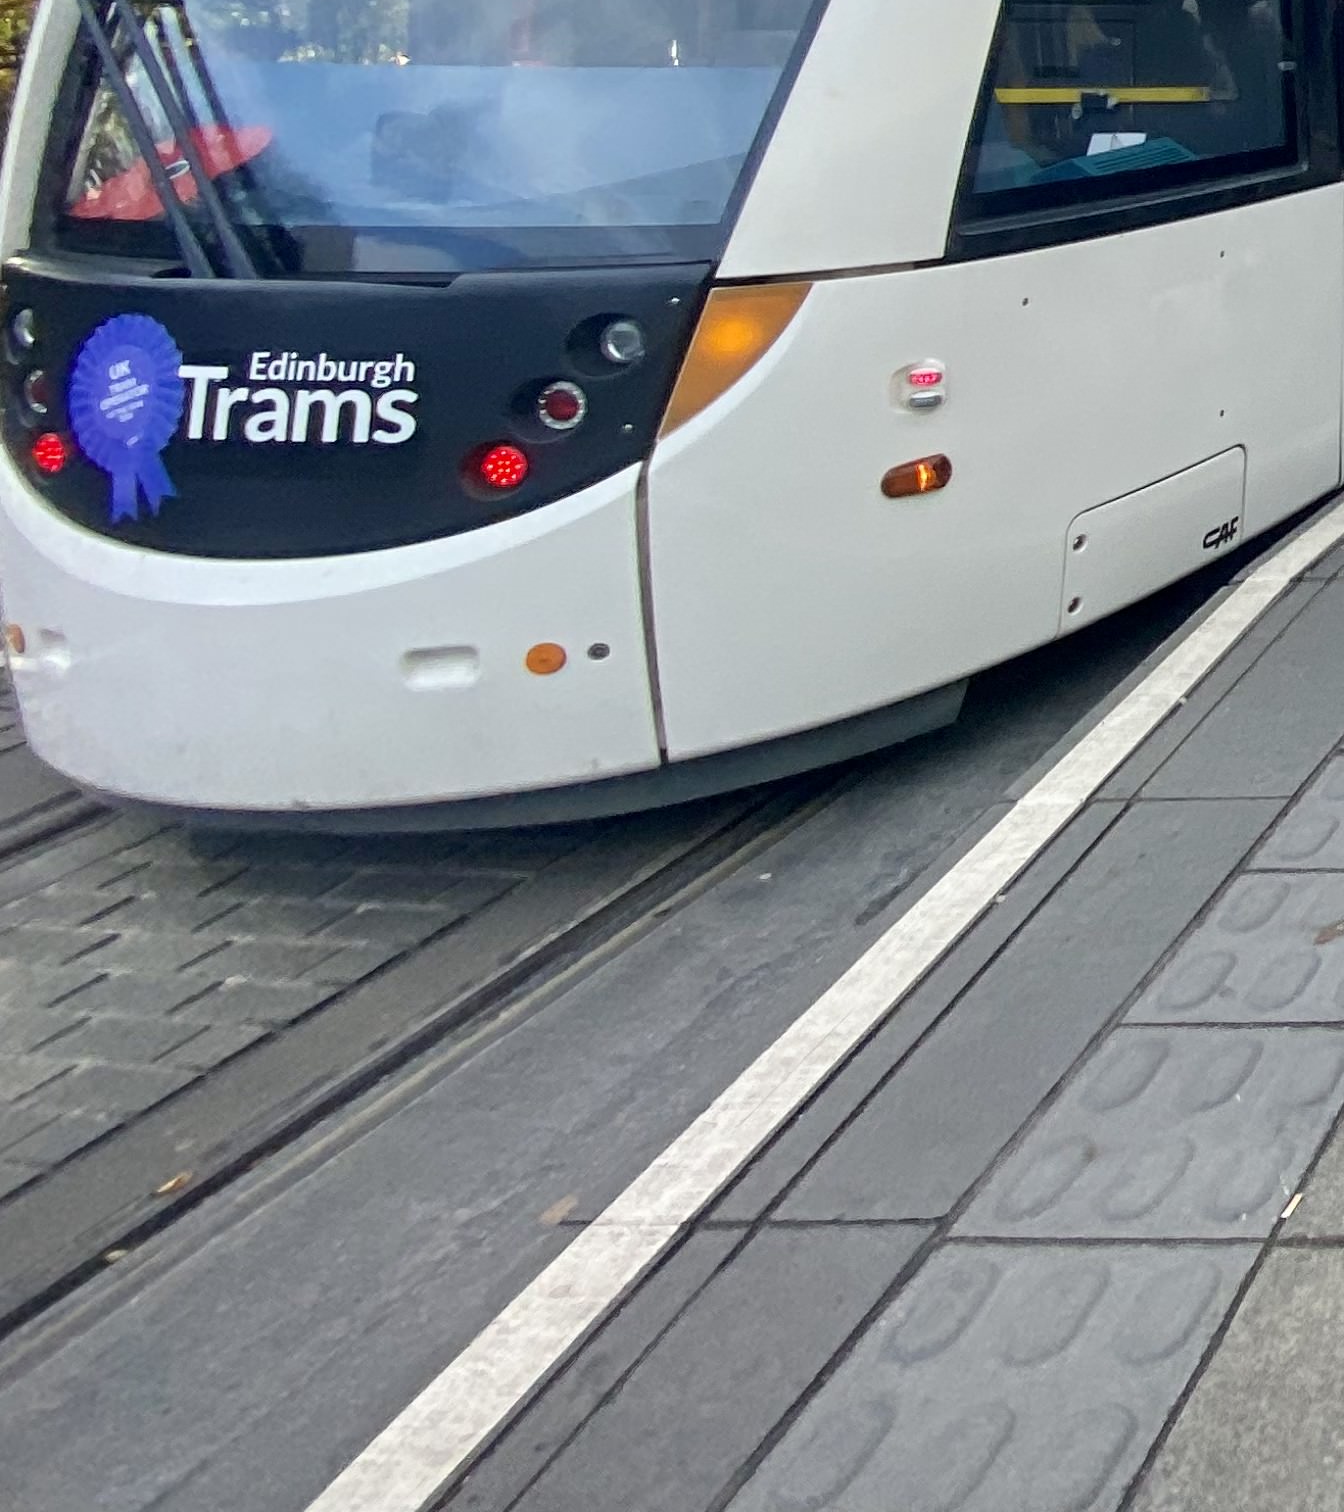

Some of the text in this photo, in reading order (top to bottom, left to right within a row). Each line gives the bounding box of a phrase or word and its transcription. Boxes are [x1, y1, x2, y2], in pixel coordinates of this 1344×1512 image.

[109, 360, 131, 380] UK
[250, 351, 415, 388] Edinburgh
[178, 364, 419, 444] Trams
[1203, 516, 1239, 549] CAF
